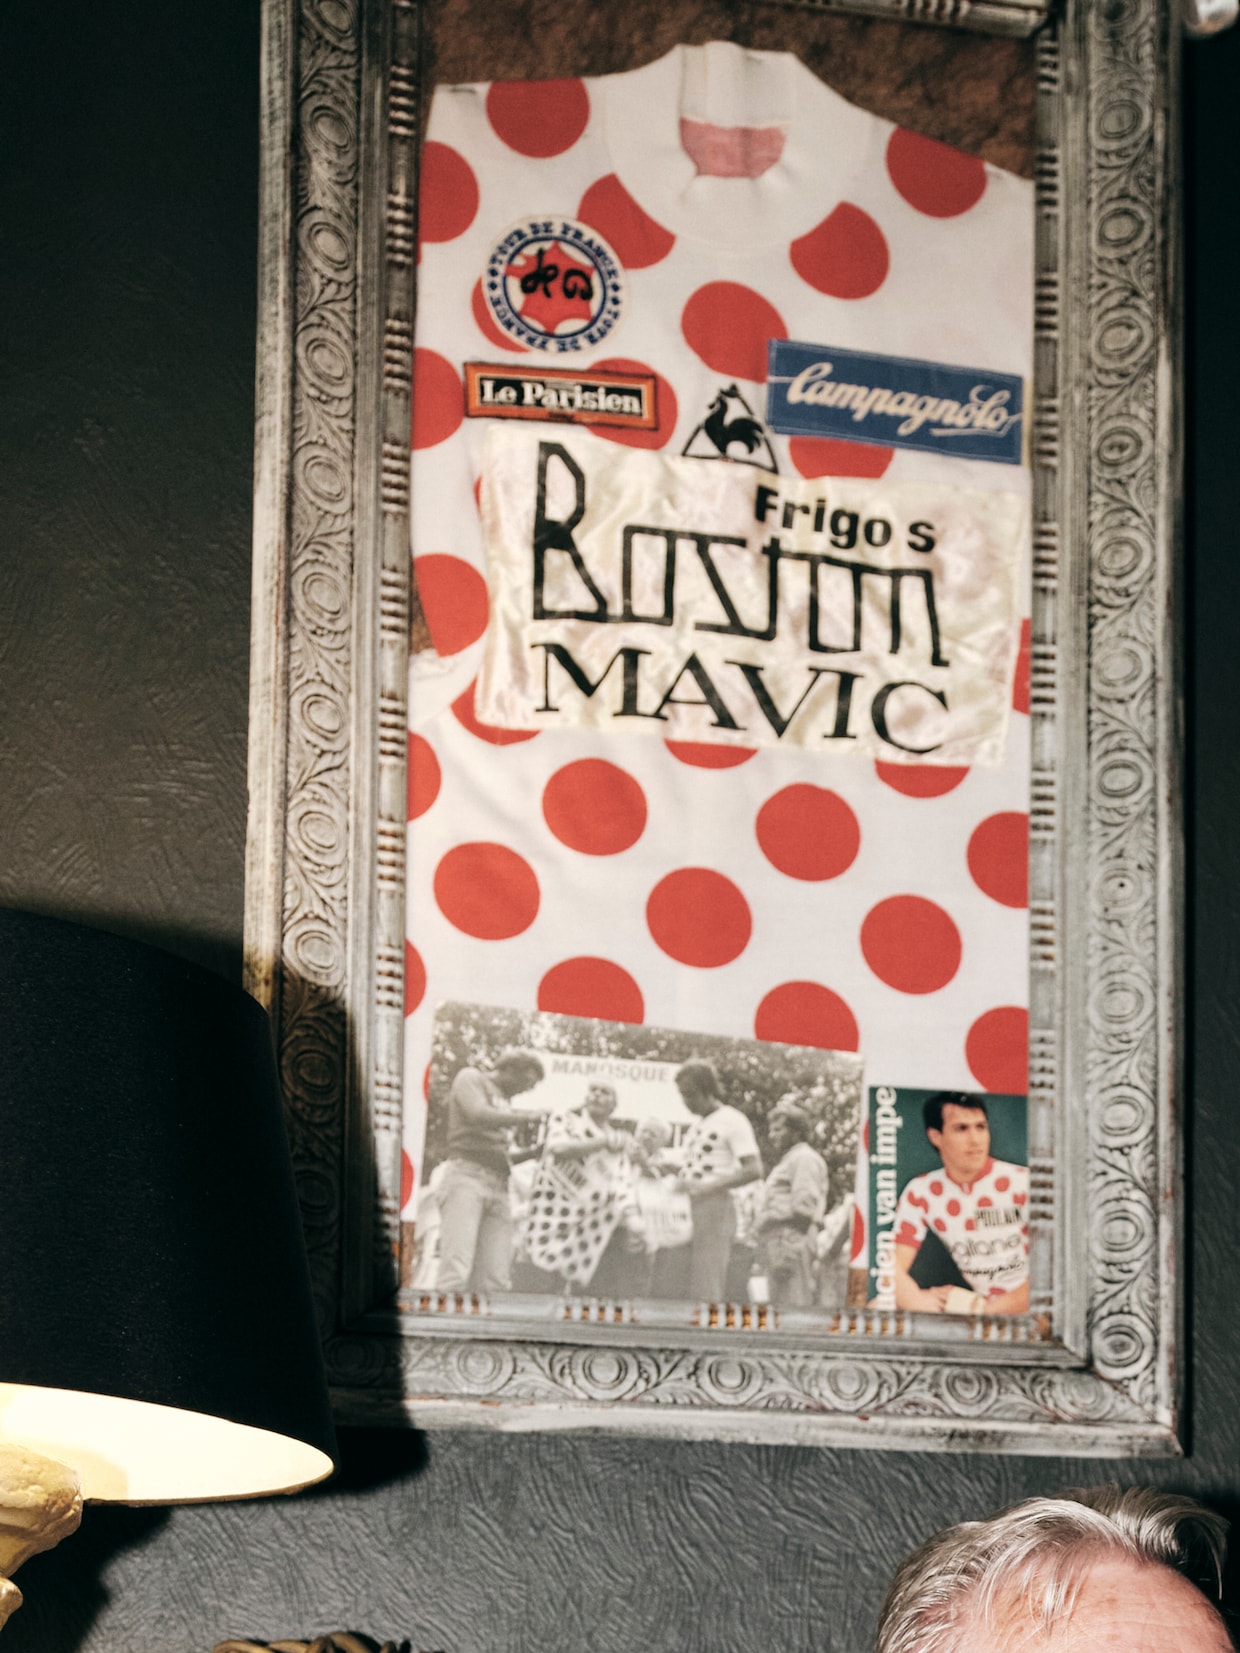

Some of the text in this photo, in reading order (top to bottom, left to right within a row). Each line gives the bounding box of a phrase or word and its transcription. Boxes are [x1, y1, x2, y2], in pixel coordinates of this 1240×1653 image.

[490, 222, 618, 278] TOUR DE FRANCE
[482, 379, 642, 414] Le Parisien
[769, 361, 1021, 437] Campagnolo
[531, 642, 949, 754] MAVIC
[869, 1087, 903, 1165] impe
[876, 1169, 897, 1226] van
